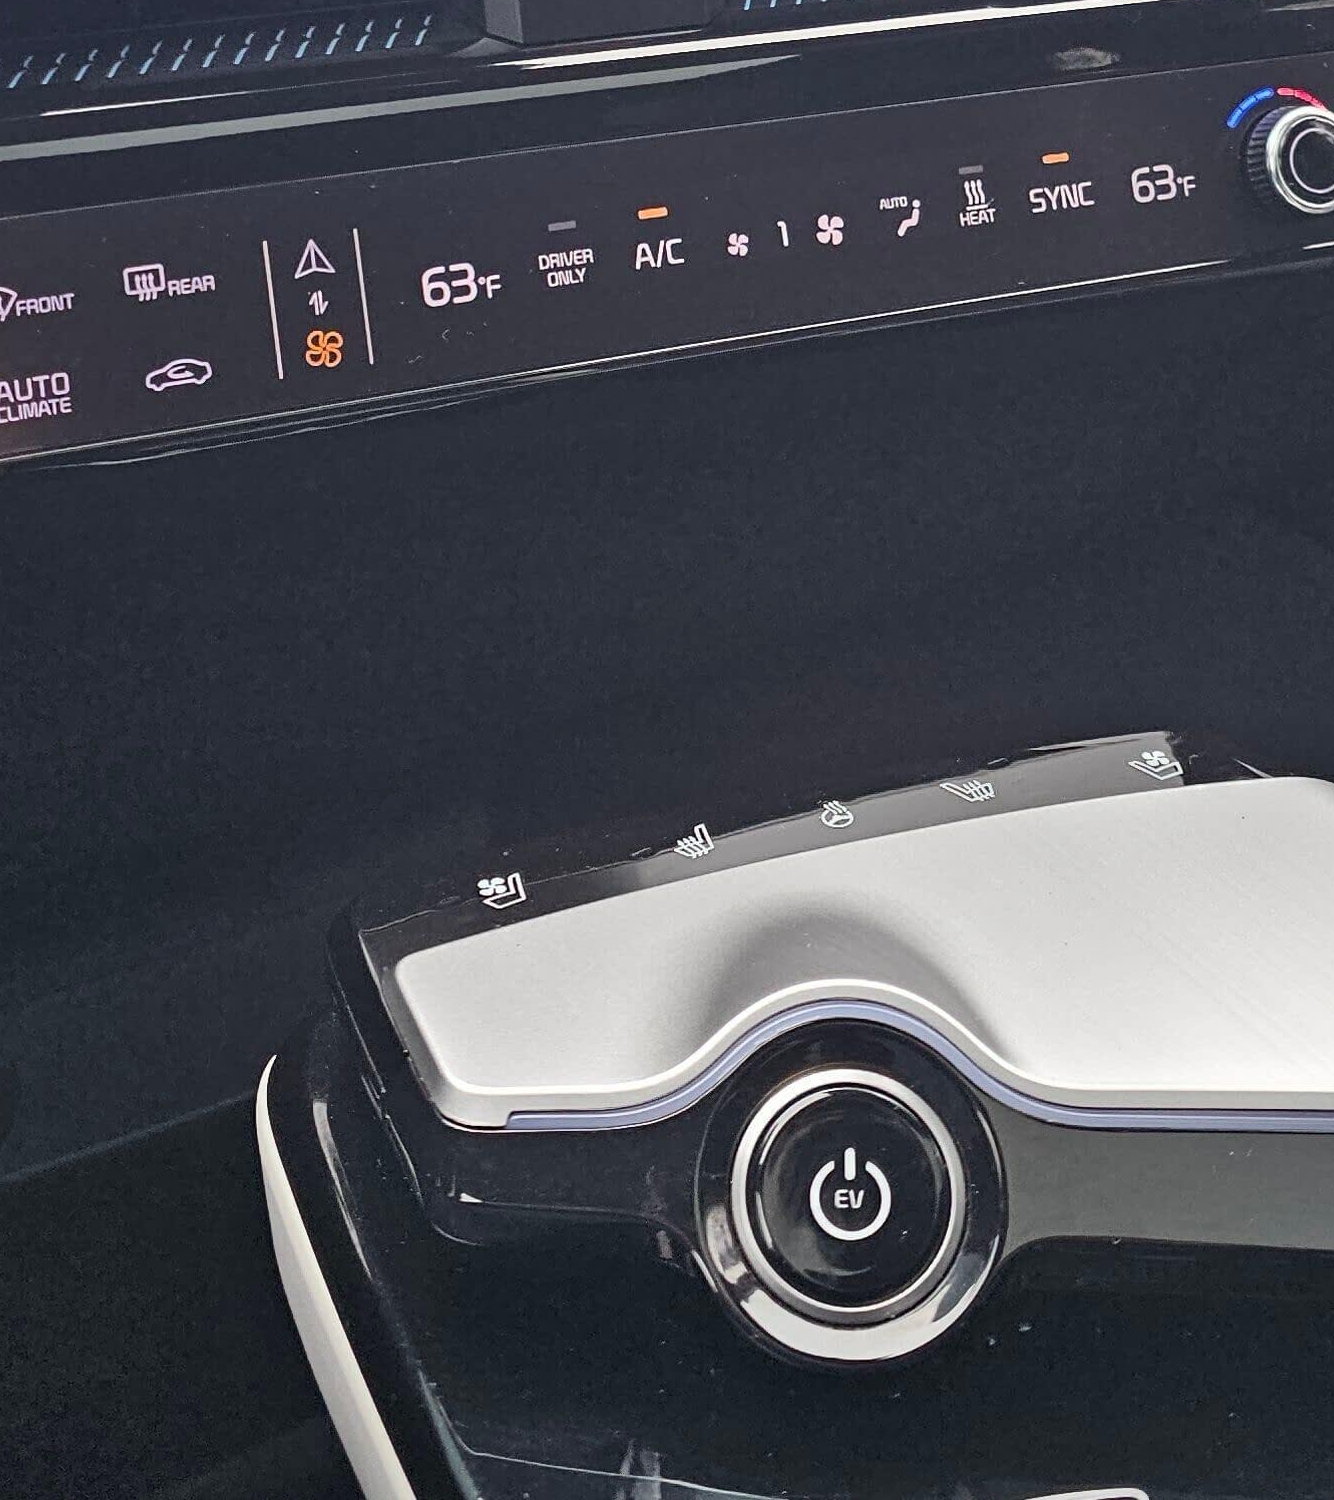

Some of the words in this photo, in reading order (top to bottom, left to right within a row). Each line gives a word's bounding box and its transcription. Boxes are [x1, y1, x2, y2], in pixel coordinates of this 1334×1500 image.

[879, 195, 908, 210] AUTO
[1028, 181, 1095, 214] SYNC
[959, 208, 996, 228] HEAT
[776, 220, 789, 247] 1
[538, 248, 595, 271] DRIVER
[635, 238, 685, 270] A/C
[167, 274, 216, 297] REAR
[546, 266, 588, 288] ONLY
[15, 292, 75, 317] FRONT
[834, 1188, 865, 1209] EV
